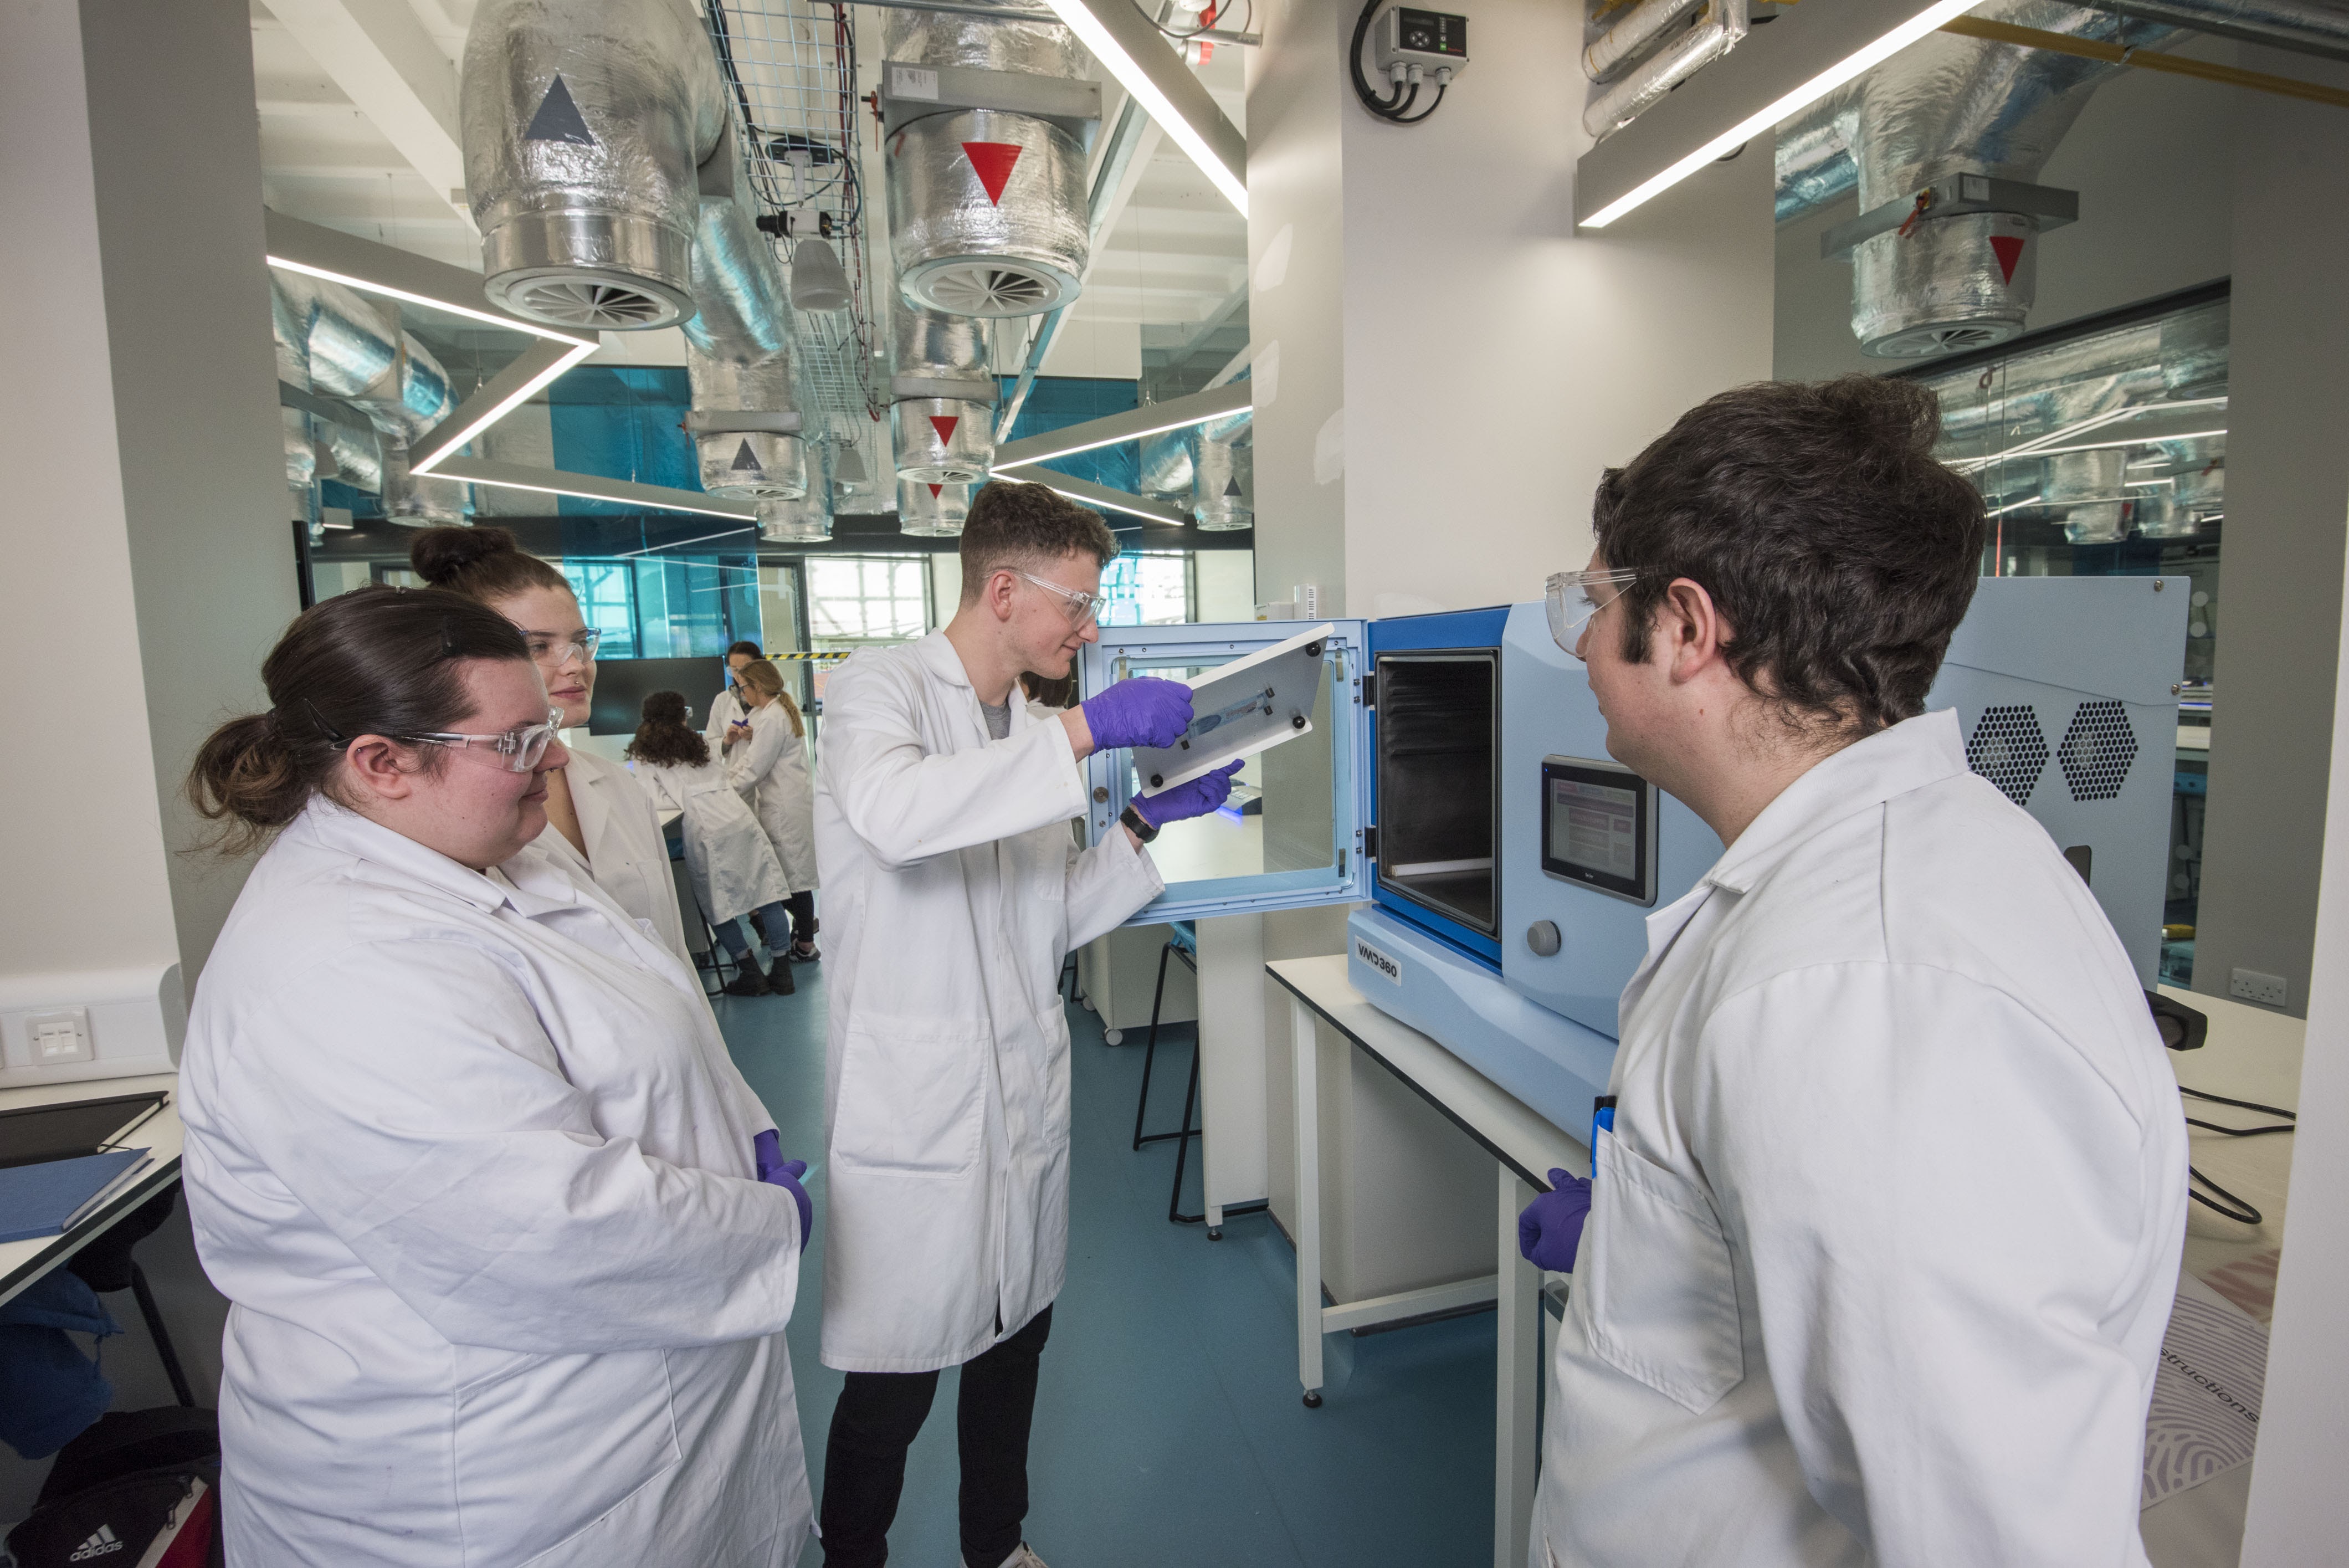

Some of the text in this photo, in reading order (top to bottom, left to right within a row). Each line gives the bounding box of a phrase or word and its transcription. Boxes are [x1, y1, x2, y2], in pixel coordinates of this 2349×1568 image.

[1358, 943, 1397, 977] VMD360
[2161, 1347, 2259, 1422] structions
[70, 1540, 124, 1562] adidas
